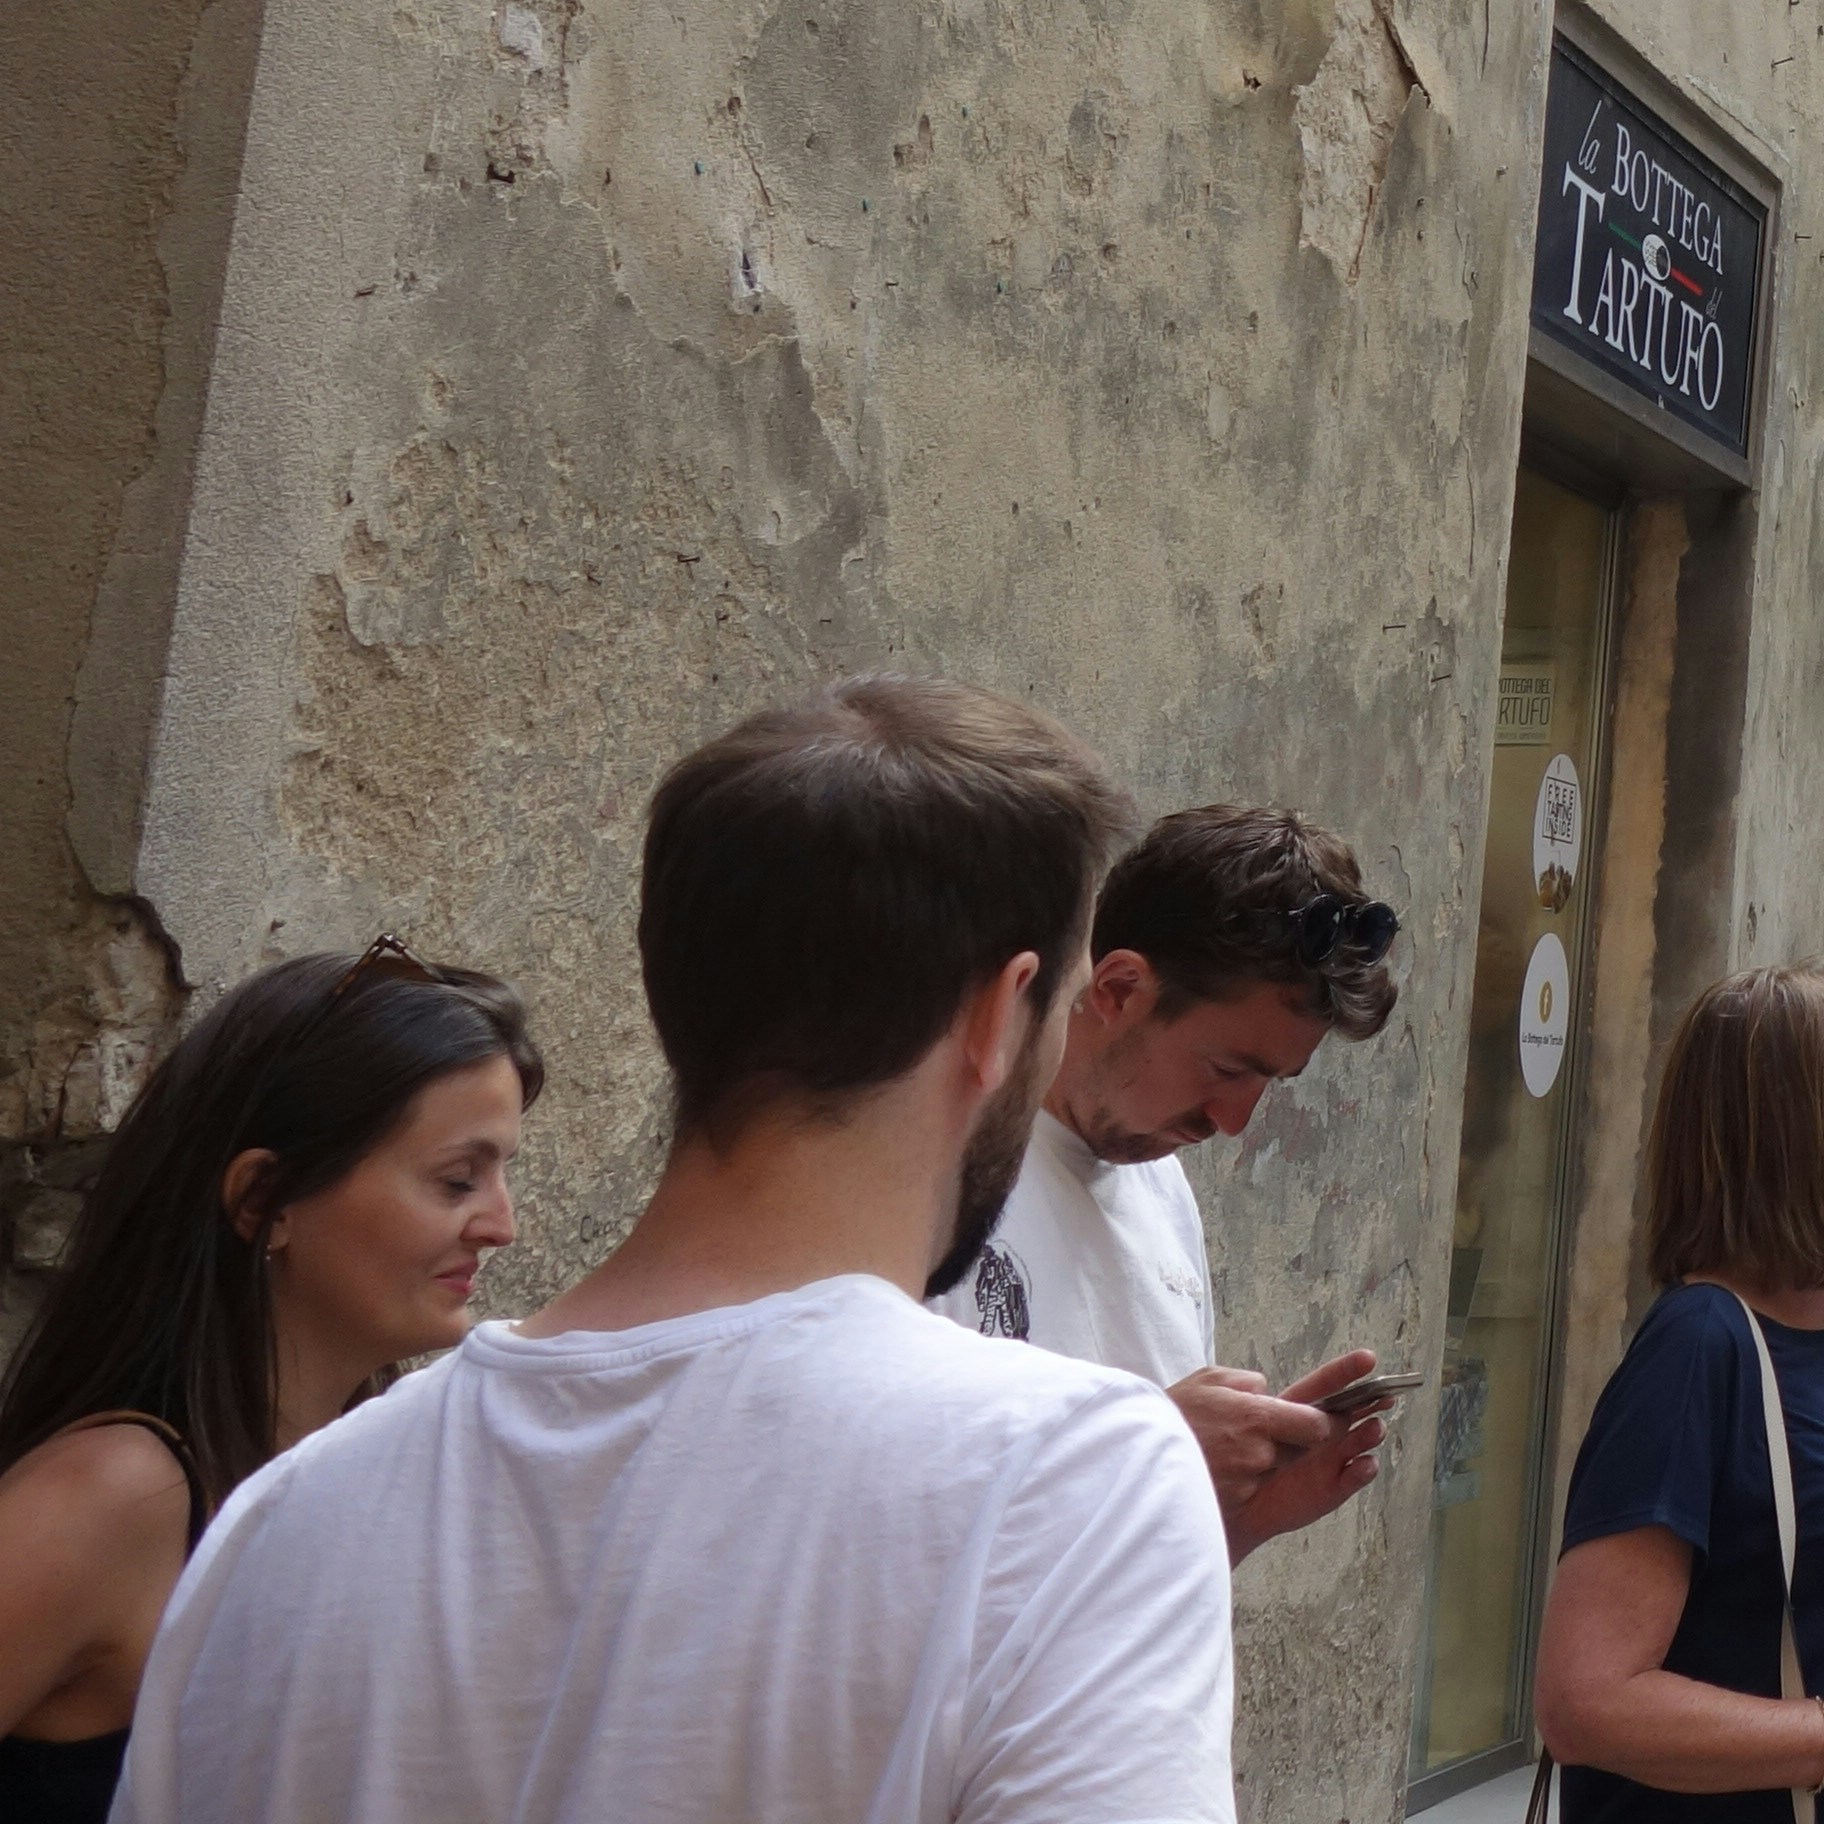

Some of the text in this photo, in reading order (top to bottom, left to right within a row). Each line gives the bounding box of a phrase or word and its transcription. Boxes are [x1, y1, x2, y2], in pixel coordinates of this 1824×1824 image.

[1611, 122, 1725, 276] BOTTEGA
[1561, 161, 1724, 412] TARTUFO
[1499, 677, 1552, 694] OTTEGA DEL
[1498, 696, 1551, 725] RTUFO
[1548, 783, 1574, 806] FREE
[1546, 817, 1572, 838] INSIDE
